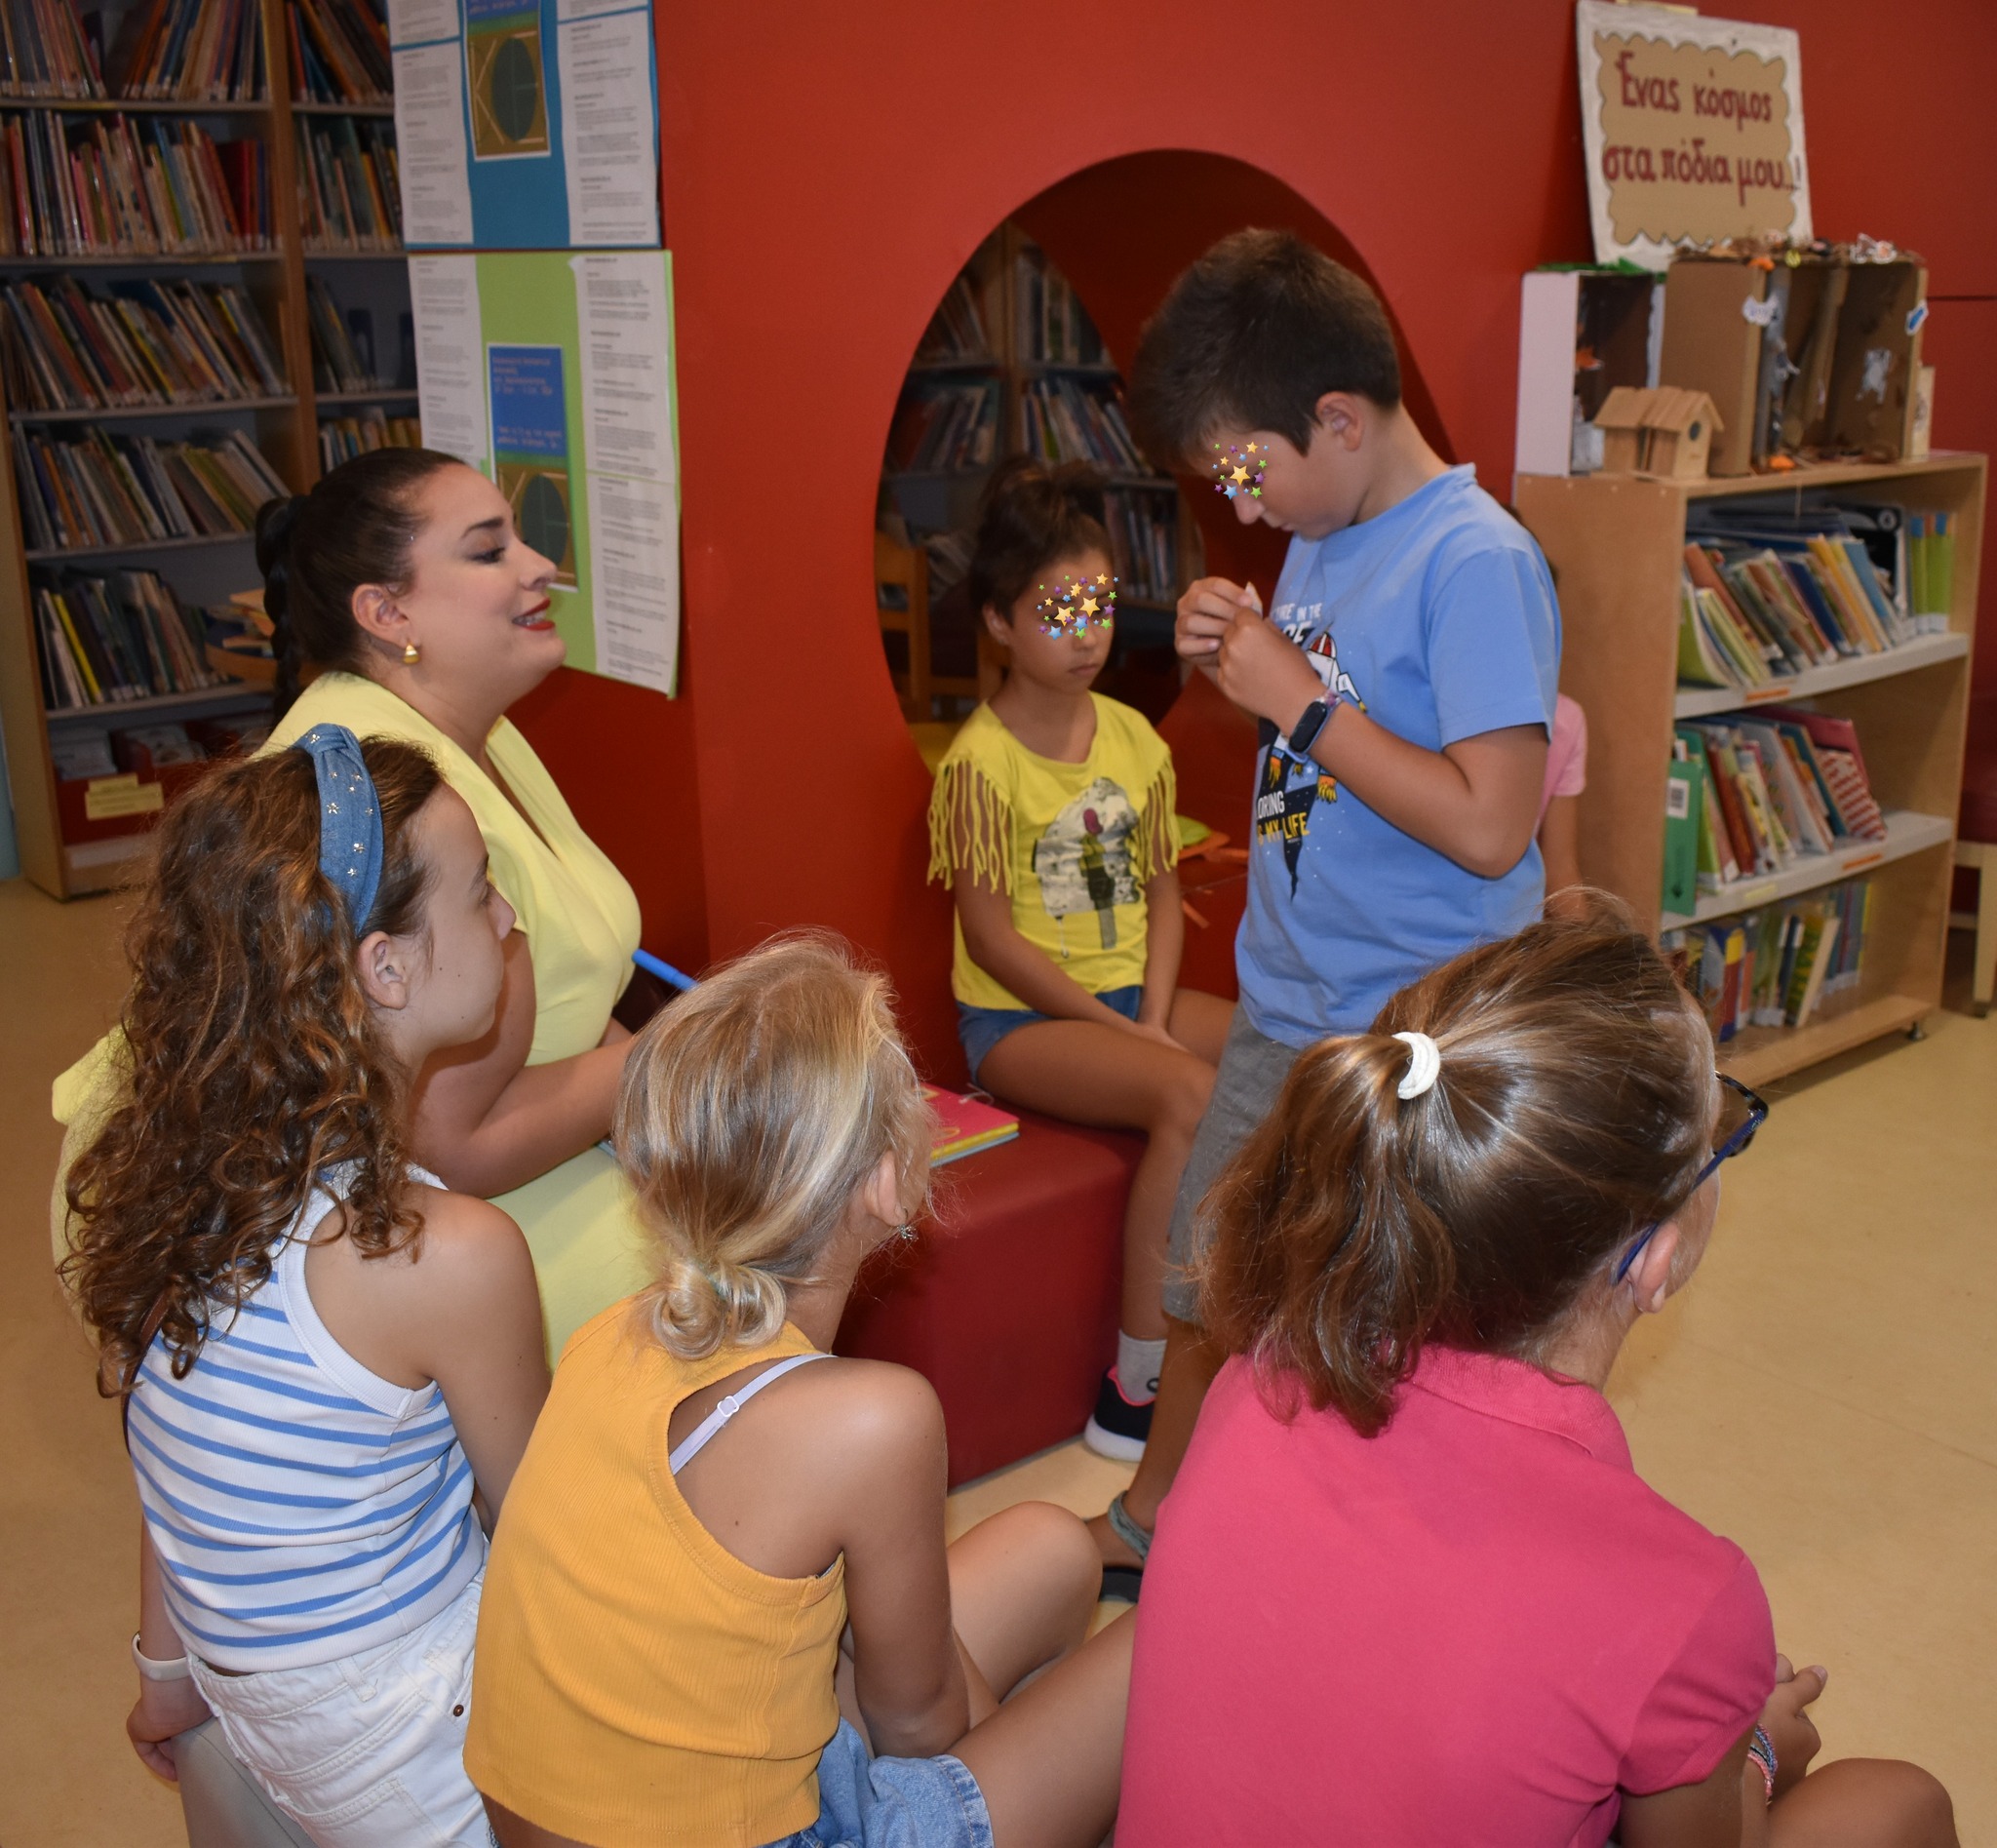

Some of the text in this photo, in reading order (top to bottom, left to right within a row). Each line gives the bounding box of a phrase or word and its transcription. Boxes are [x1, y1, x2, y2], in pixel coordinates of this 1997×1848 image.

[1693, 68, 1773, 133] κόσμος
[1602, 145, 1656, 183] στα
[1662, 138, 1732, 183] πόδια
[1281, 811, 1311, 841] LIFE
